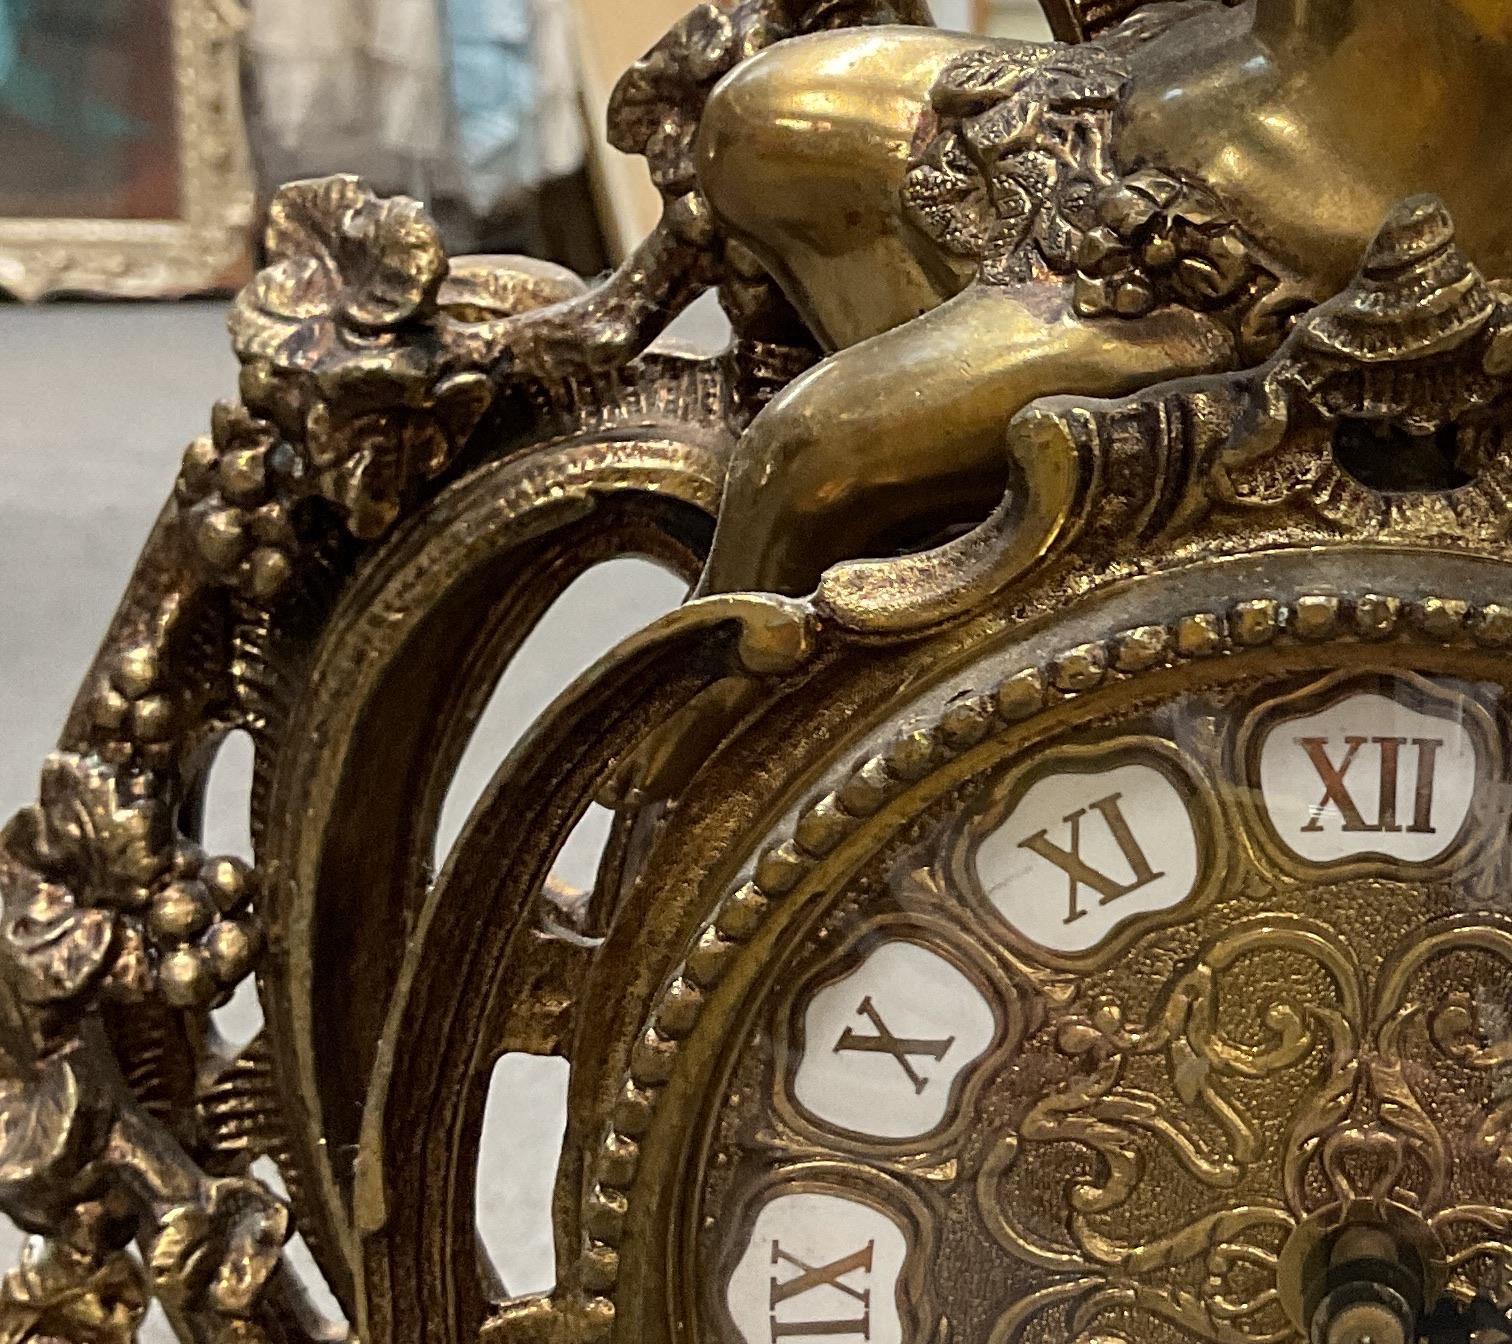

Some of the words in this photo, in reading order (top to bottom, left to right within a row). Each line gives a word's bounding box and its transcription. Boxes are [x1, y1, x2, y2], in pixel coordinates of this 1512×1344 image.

[1299, 736, 1444, 834] XII
[1017, 791, 1166, 922] XI
[833, 996, 956, 1094] X
[769, 1239, 874, 1344] IX
